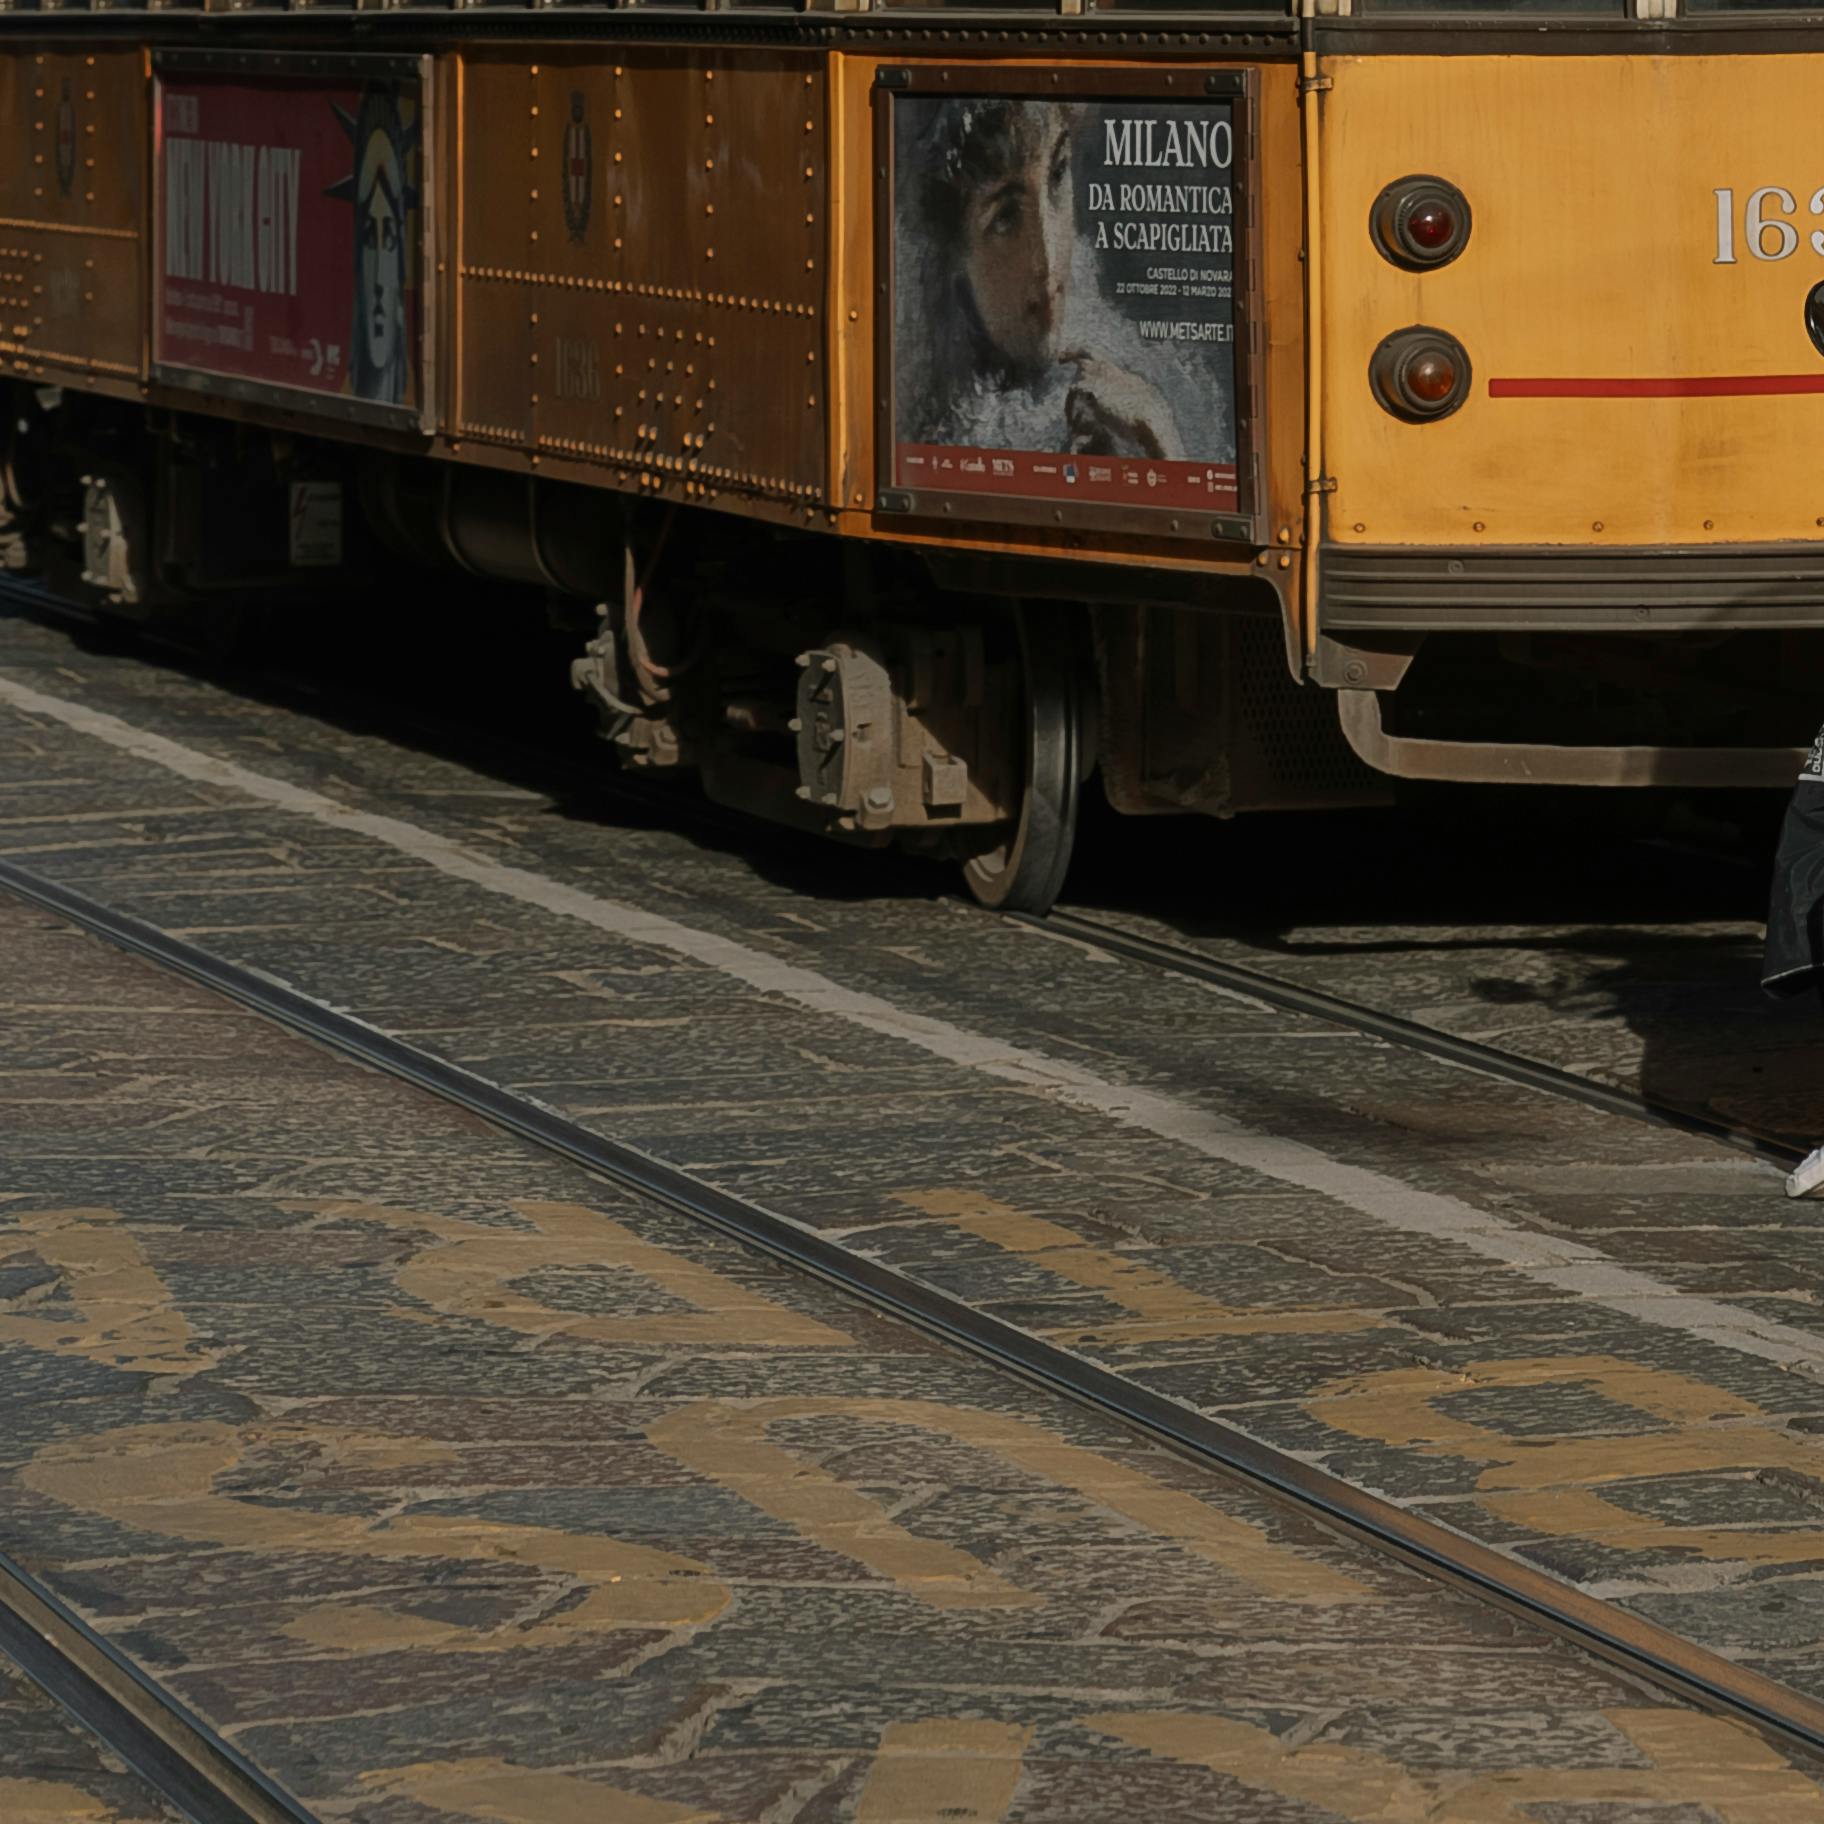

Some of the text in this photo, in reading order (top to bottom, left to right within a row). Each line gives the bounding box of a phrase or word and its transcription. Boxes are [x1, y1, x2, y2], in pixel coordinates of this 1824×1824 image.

[1103, 119, 1232, 168] MILANO
[1088, 183, 1232, 214] DA ROMANTICA
[258, 145, 302, 295] CITY
[1095, 221, 1232, 253] A SCAPIGLIATA
[1146, 267, 1188, 281] CASTELLO
[1189, 268, 1198, 281] DI
[1126, 283, 1159, 295] OTTOBRE
[1160, 284, 1177, 296] 2022
[1182, 285, 1190, 296] 12
[1191, 285, 1217, 297] MARZO
[1218, 287, 1231, 298] 202
